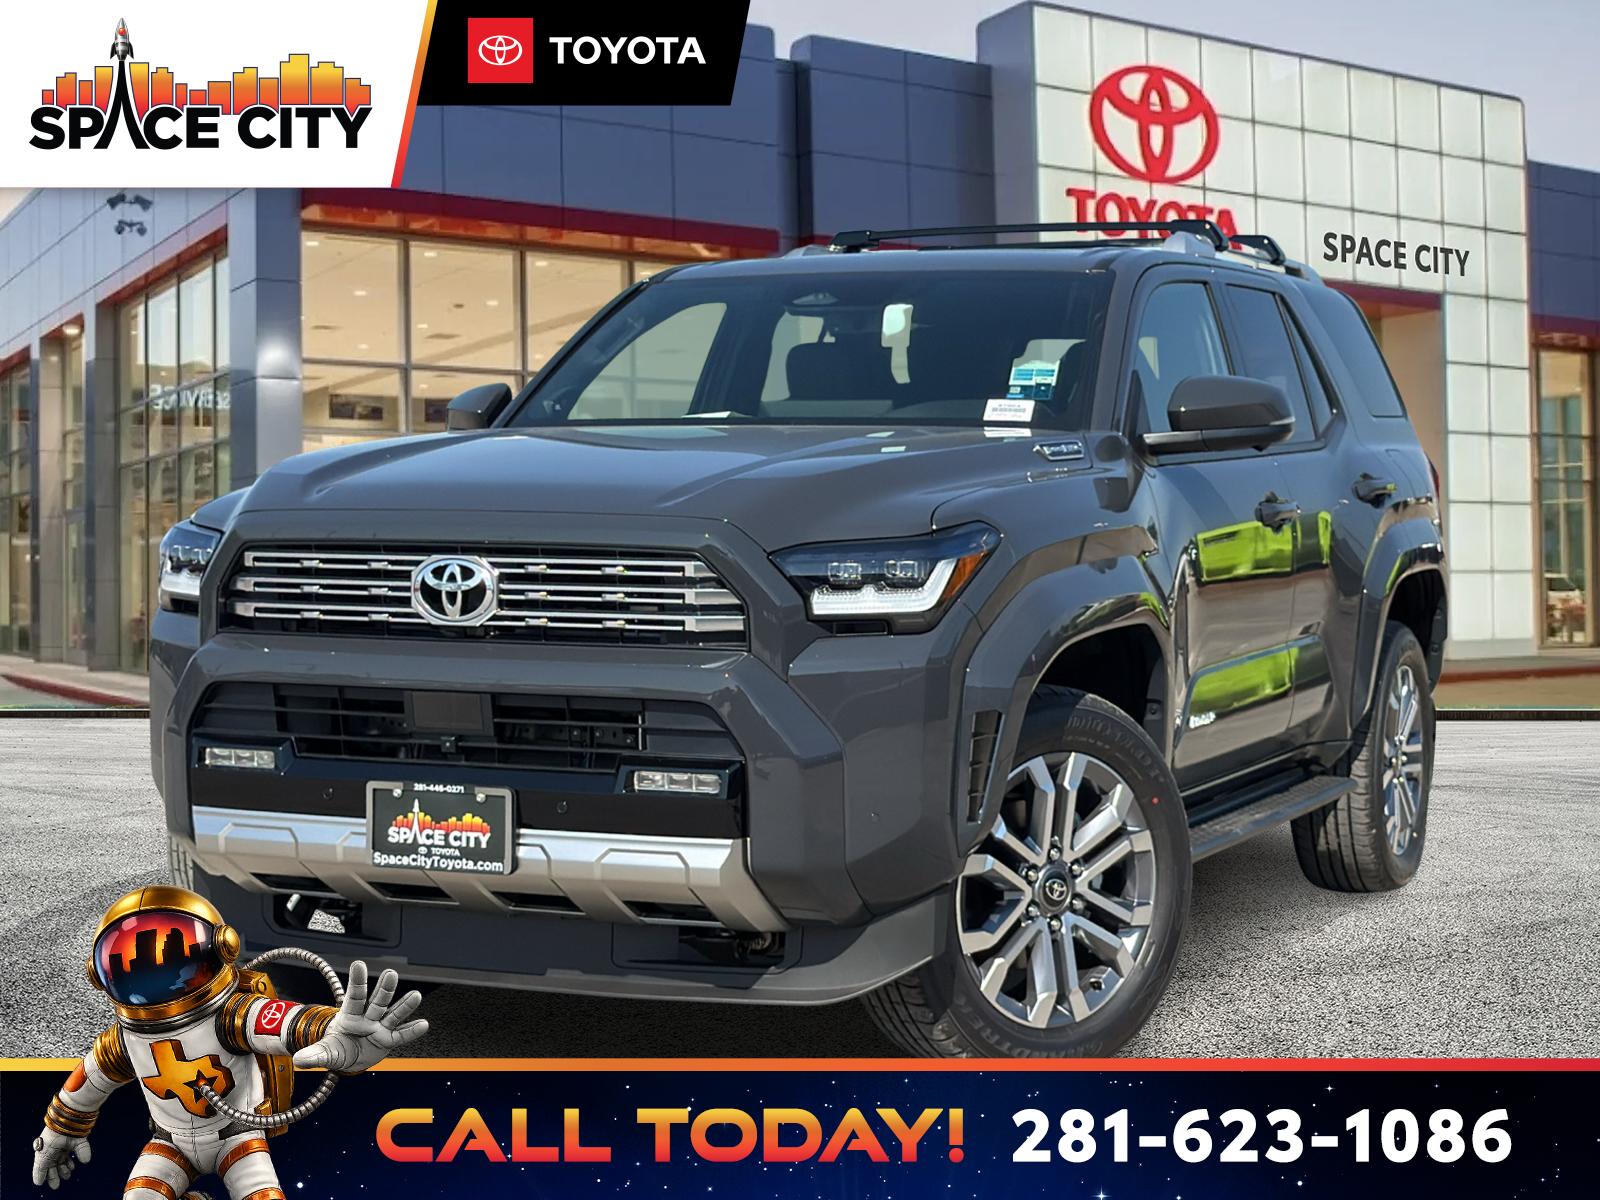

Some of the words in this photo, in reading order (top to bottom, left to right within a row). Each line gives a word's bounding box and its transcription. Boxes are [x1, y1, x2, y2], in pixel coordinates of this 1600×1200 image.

[1323, 232, 1407, 270] SPACE
[1414, 244, 1470, 277] CITY
[387, 826, 446, 845] SPACE
[448, 831, 491, 848] CITY
[373, 852, 504, 873] SpaceCityToyota.com
[430, 847, 461, 857] TOYOTA
